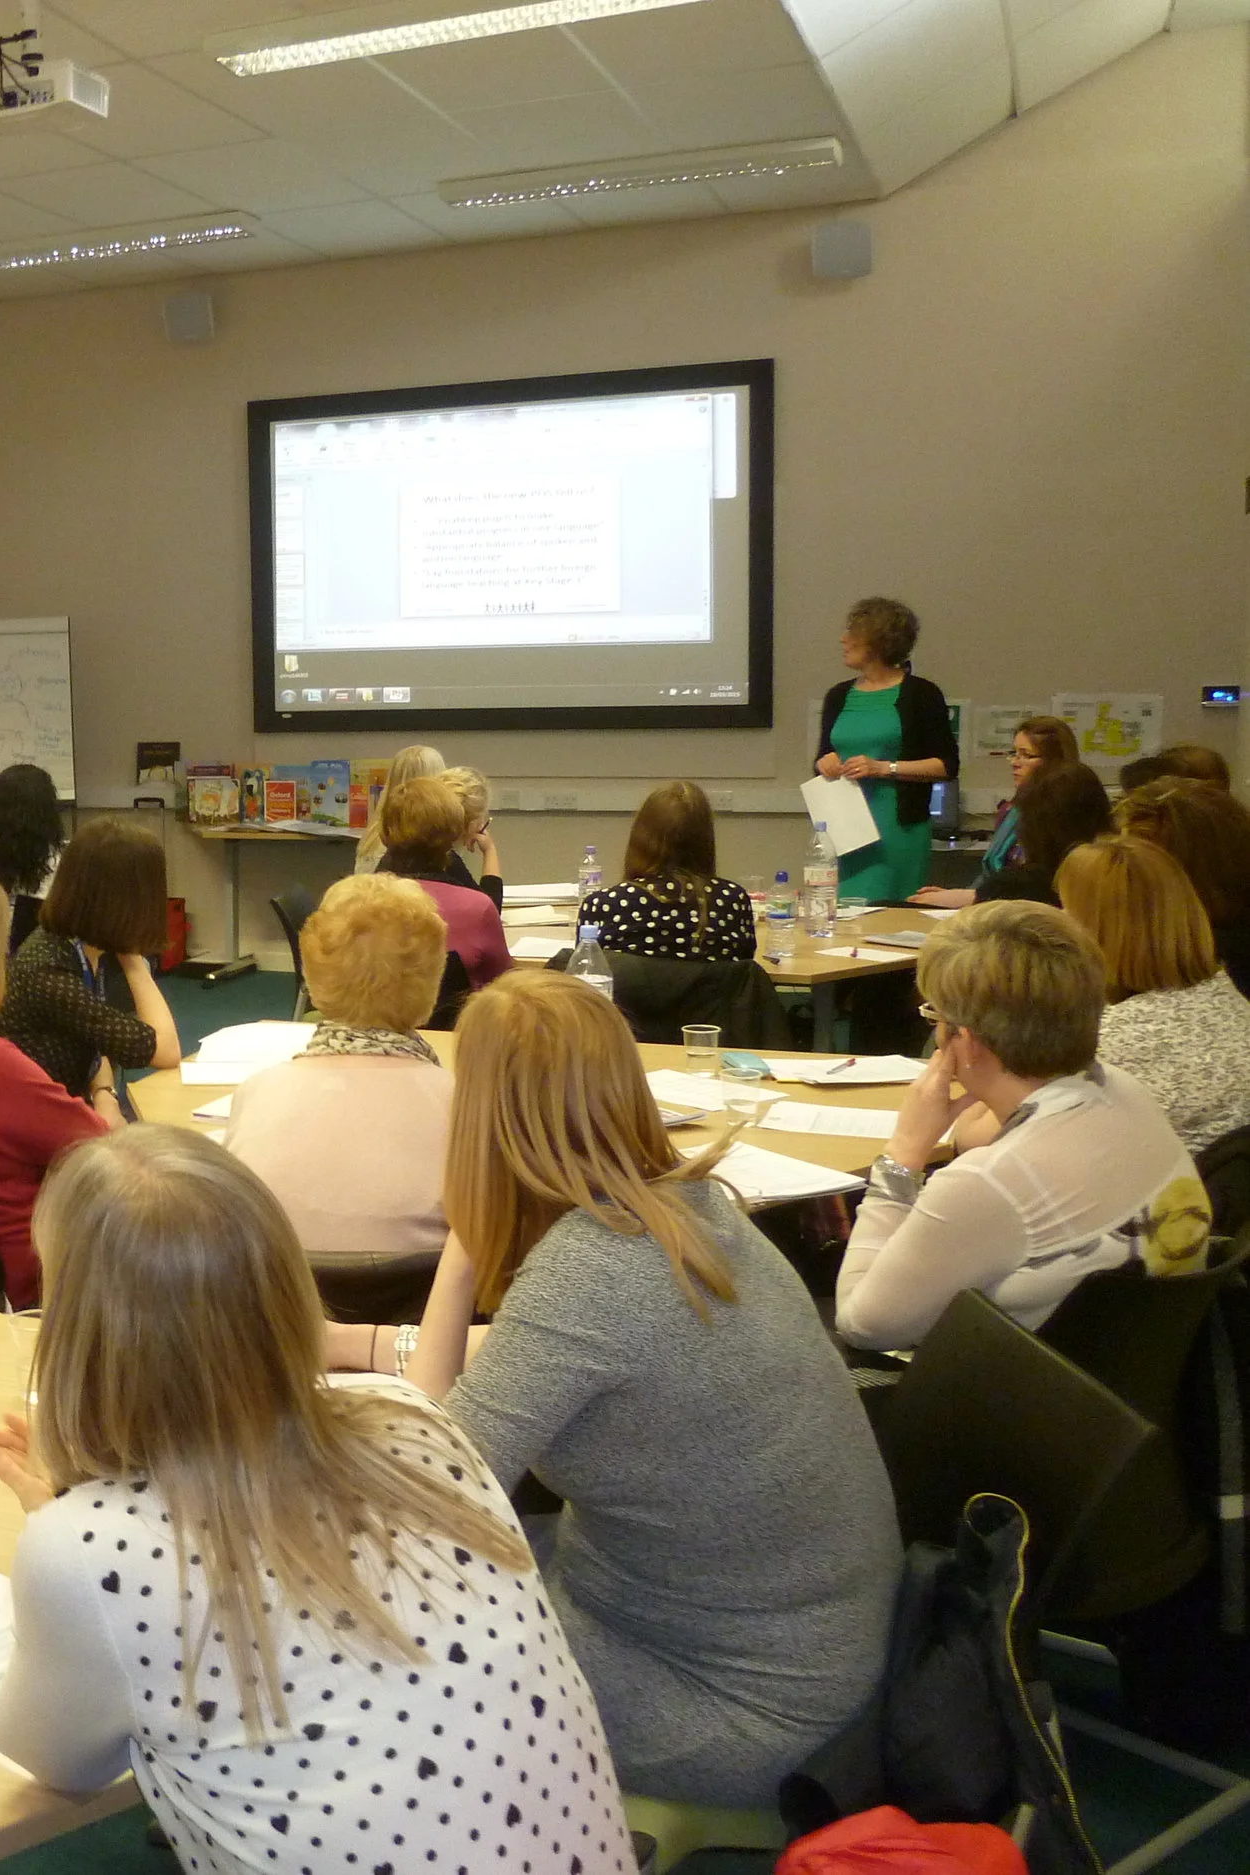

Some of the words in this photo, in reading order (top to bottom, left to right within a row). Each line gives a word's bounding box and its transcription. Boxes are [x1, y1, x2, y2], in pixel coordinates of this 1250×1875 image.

[423, 494, 451, 505] What
[483, 491, 502, 501] the
[504, 491, 527, 500] new
